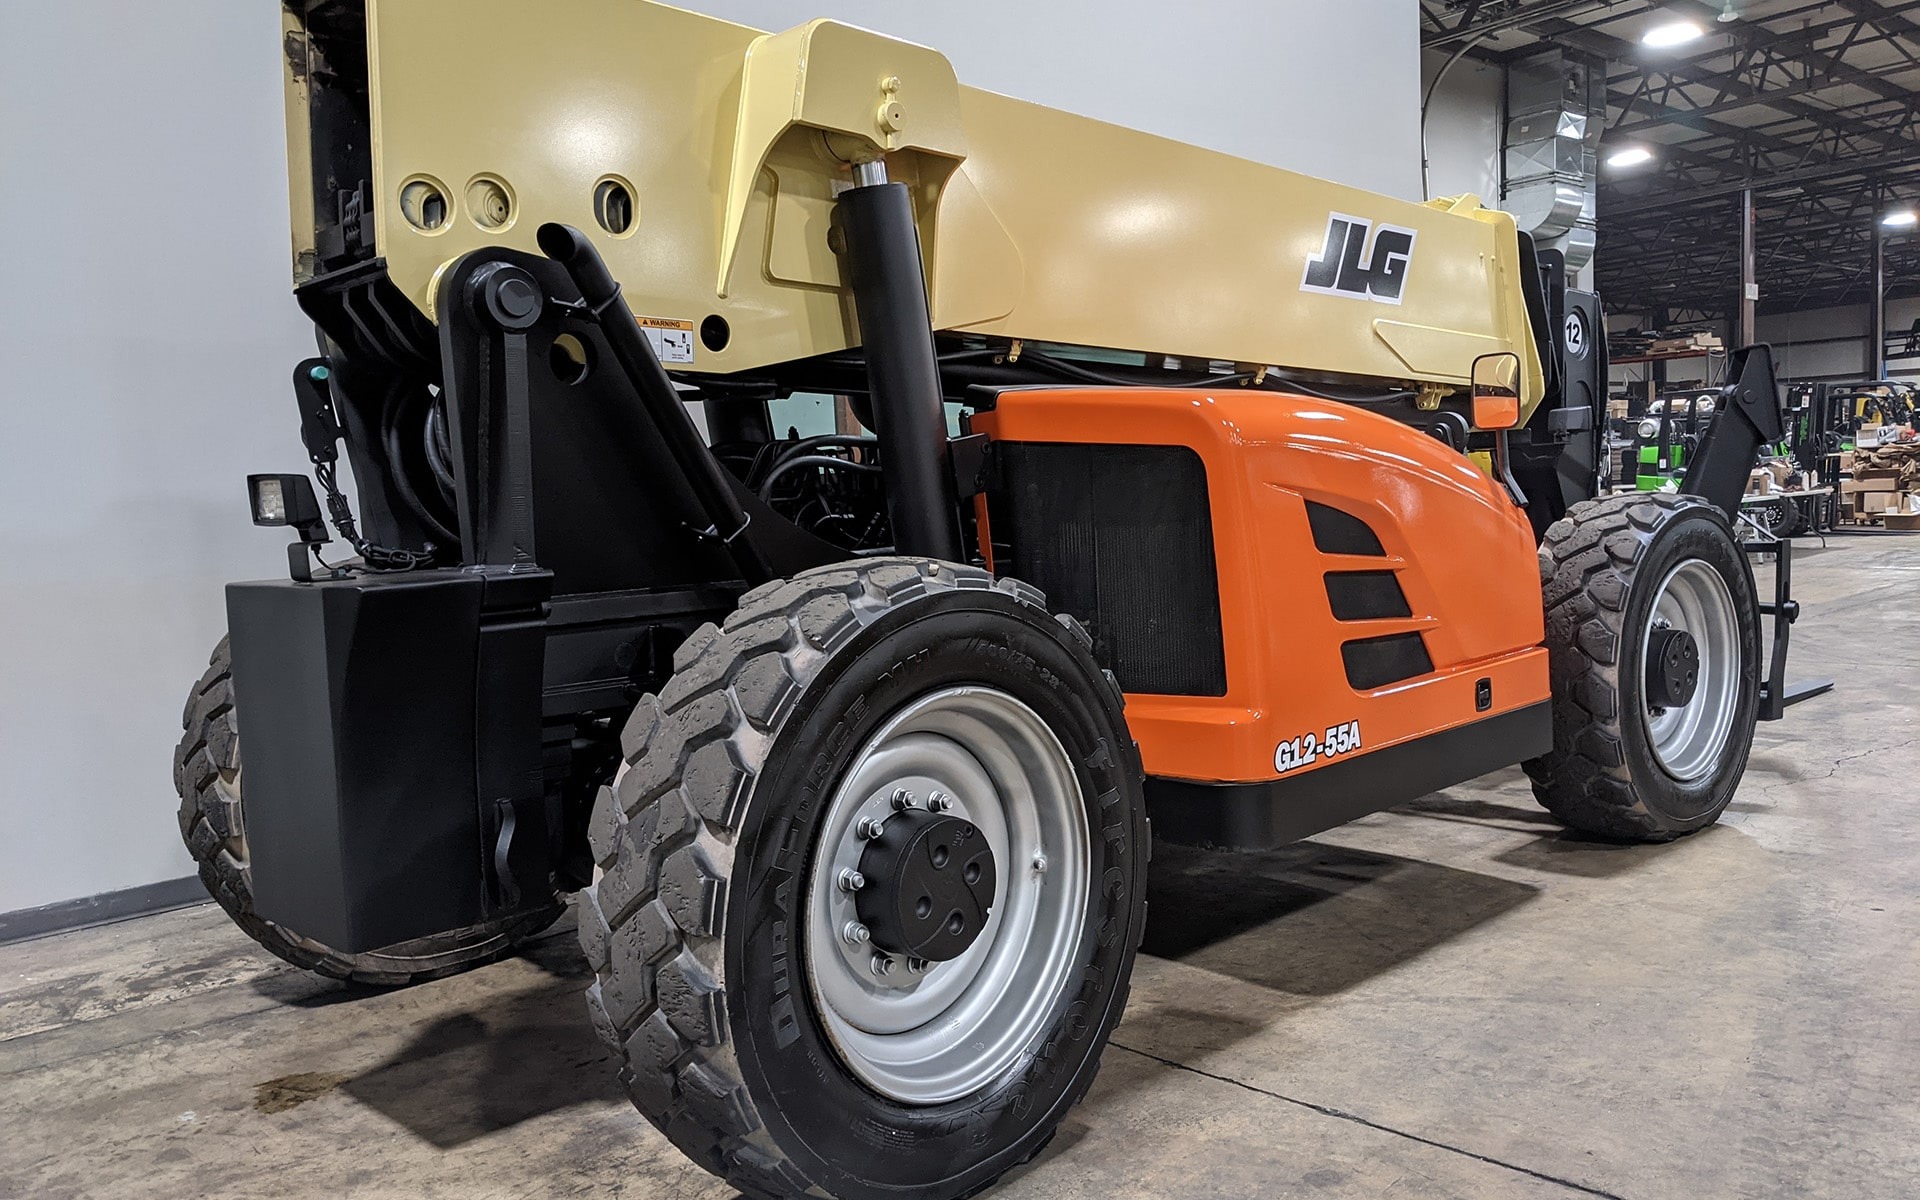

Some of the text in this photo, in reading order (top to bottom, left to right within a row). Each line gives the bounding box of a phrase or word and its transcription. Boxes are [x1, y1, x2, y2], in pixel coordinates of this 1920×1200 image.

[1304, 218, 1413, 300] JLG
[649, 319, 681, 329] WARNING
[1566, 321, 1580, 345] 12
[1274, 719, 1362, 773] G12-55A
